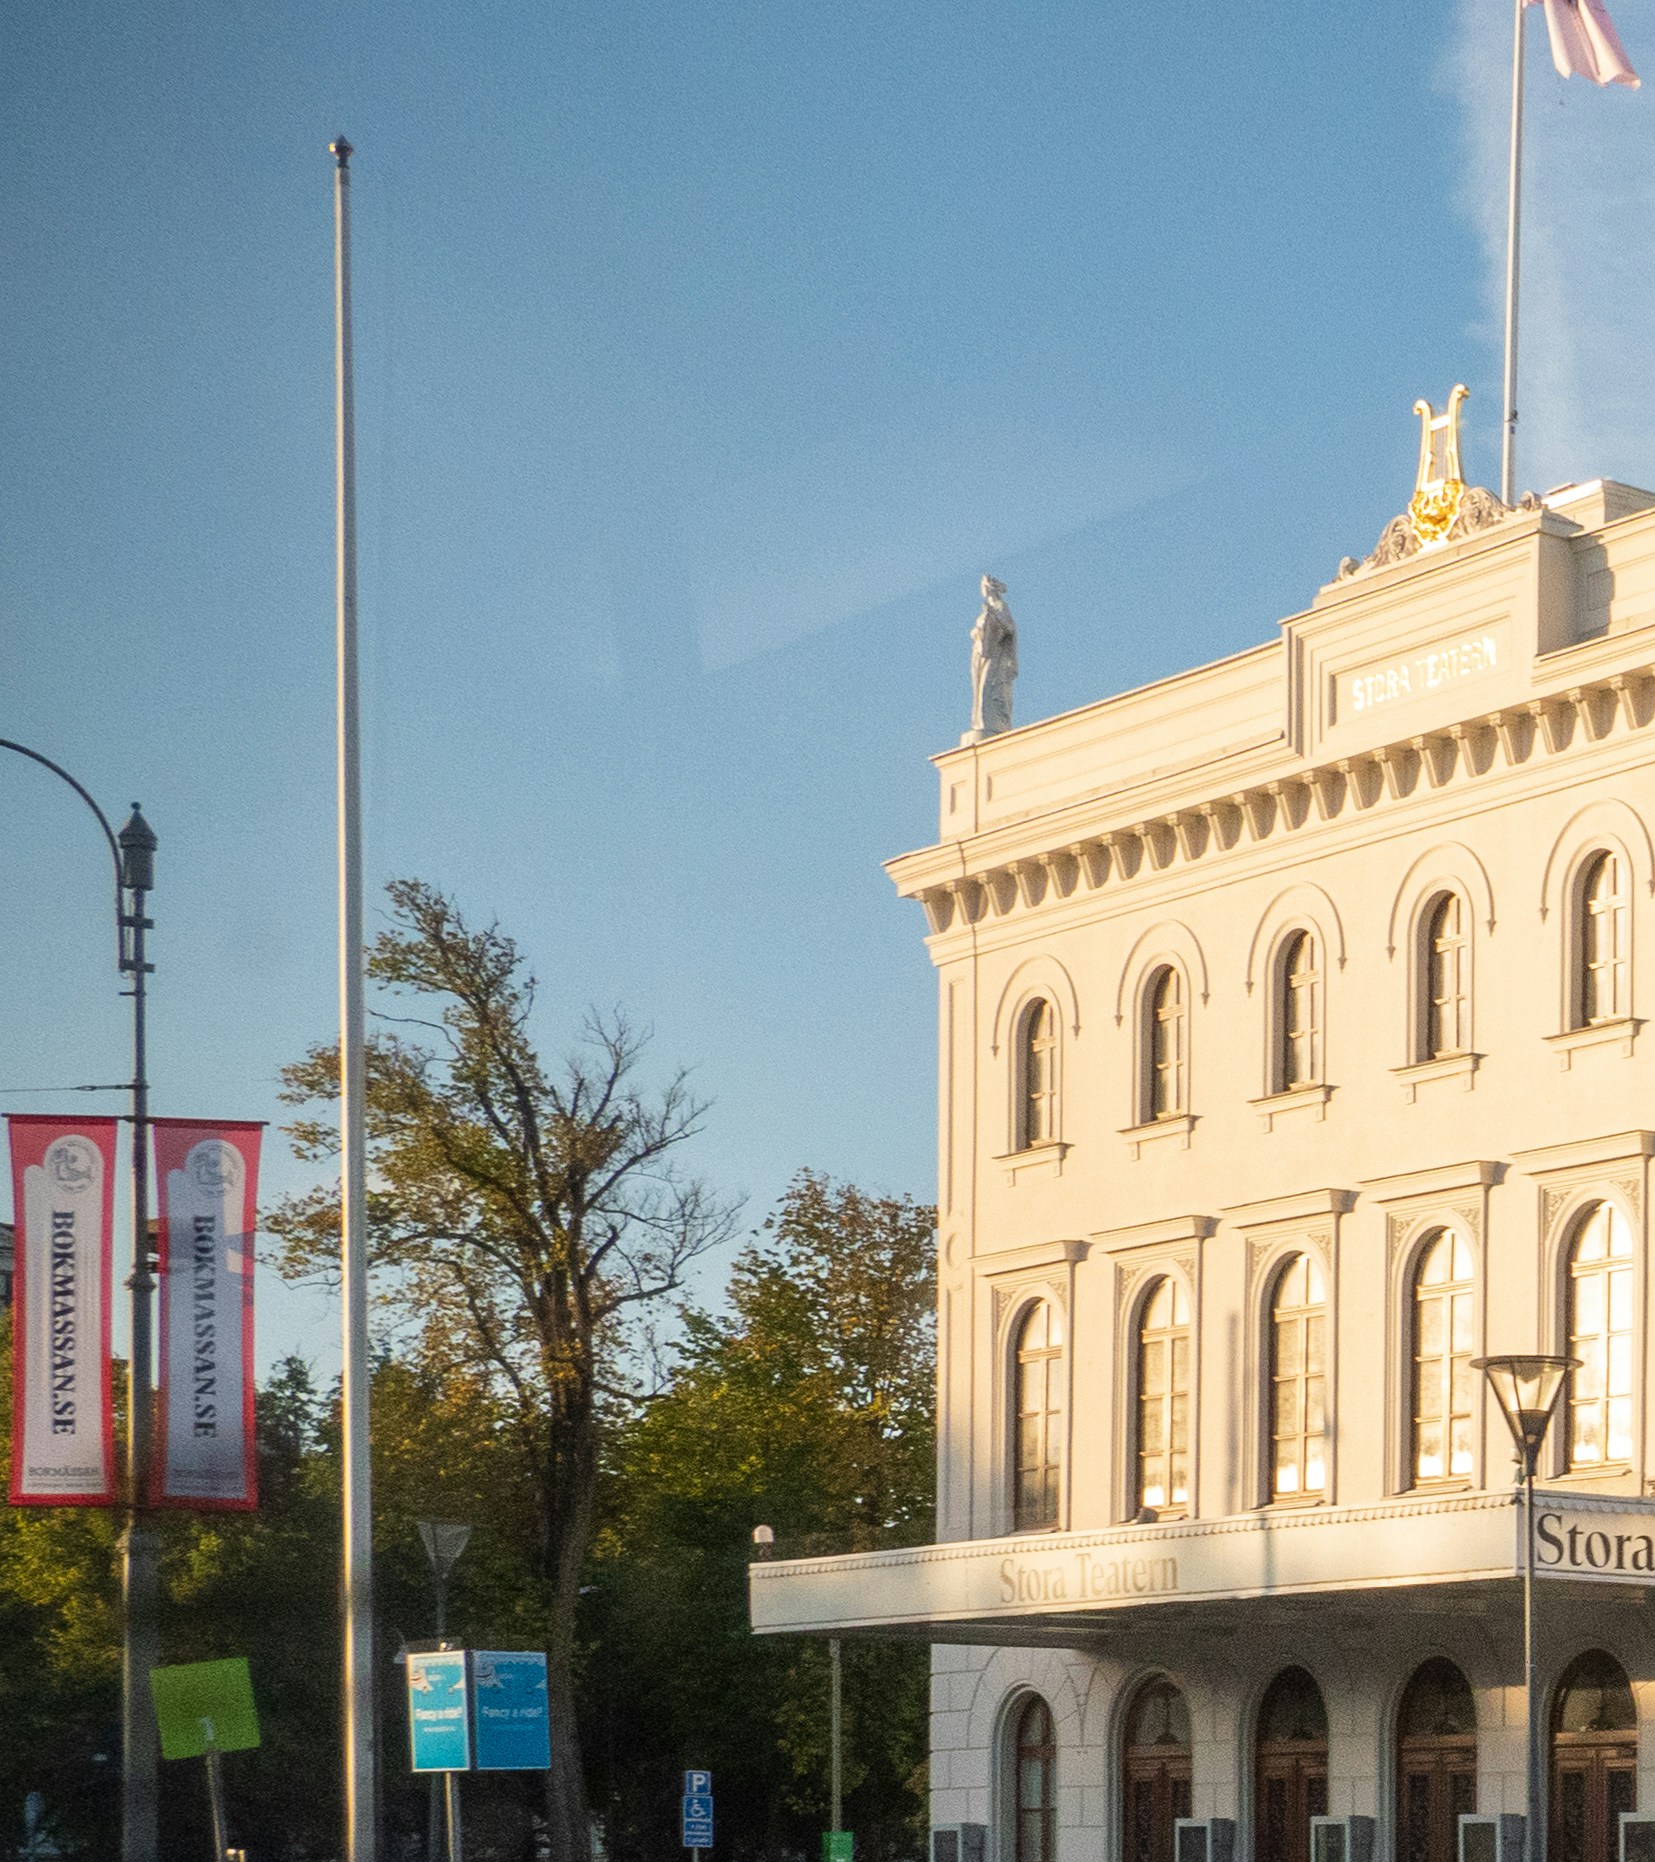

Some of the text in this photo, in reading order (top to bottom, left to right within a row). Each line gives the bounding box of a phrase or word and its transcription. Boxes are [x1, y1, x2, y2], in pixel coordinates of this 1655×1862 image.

[1352, 636, 1498, 711] STORA TEATERN
[51, 1211, 77, 1437] BOKMASSAN.SE
[192, 1215, 218, 1439] BOKMASSAN.SE
[1536, 1512, 1655, 1572] Stora
[999, 1552, 1180, 1604] Stora Teatern
[692, 1774, 706, 1792] P
